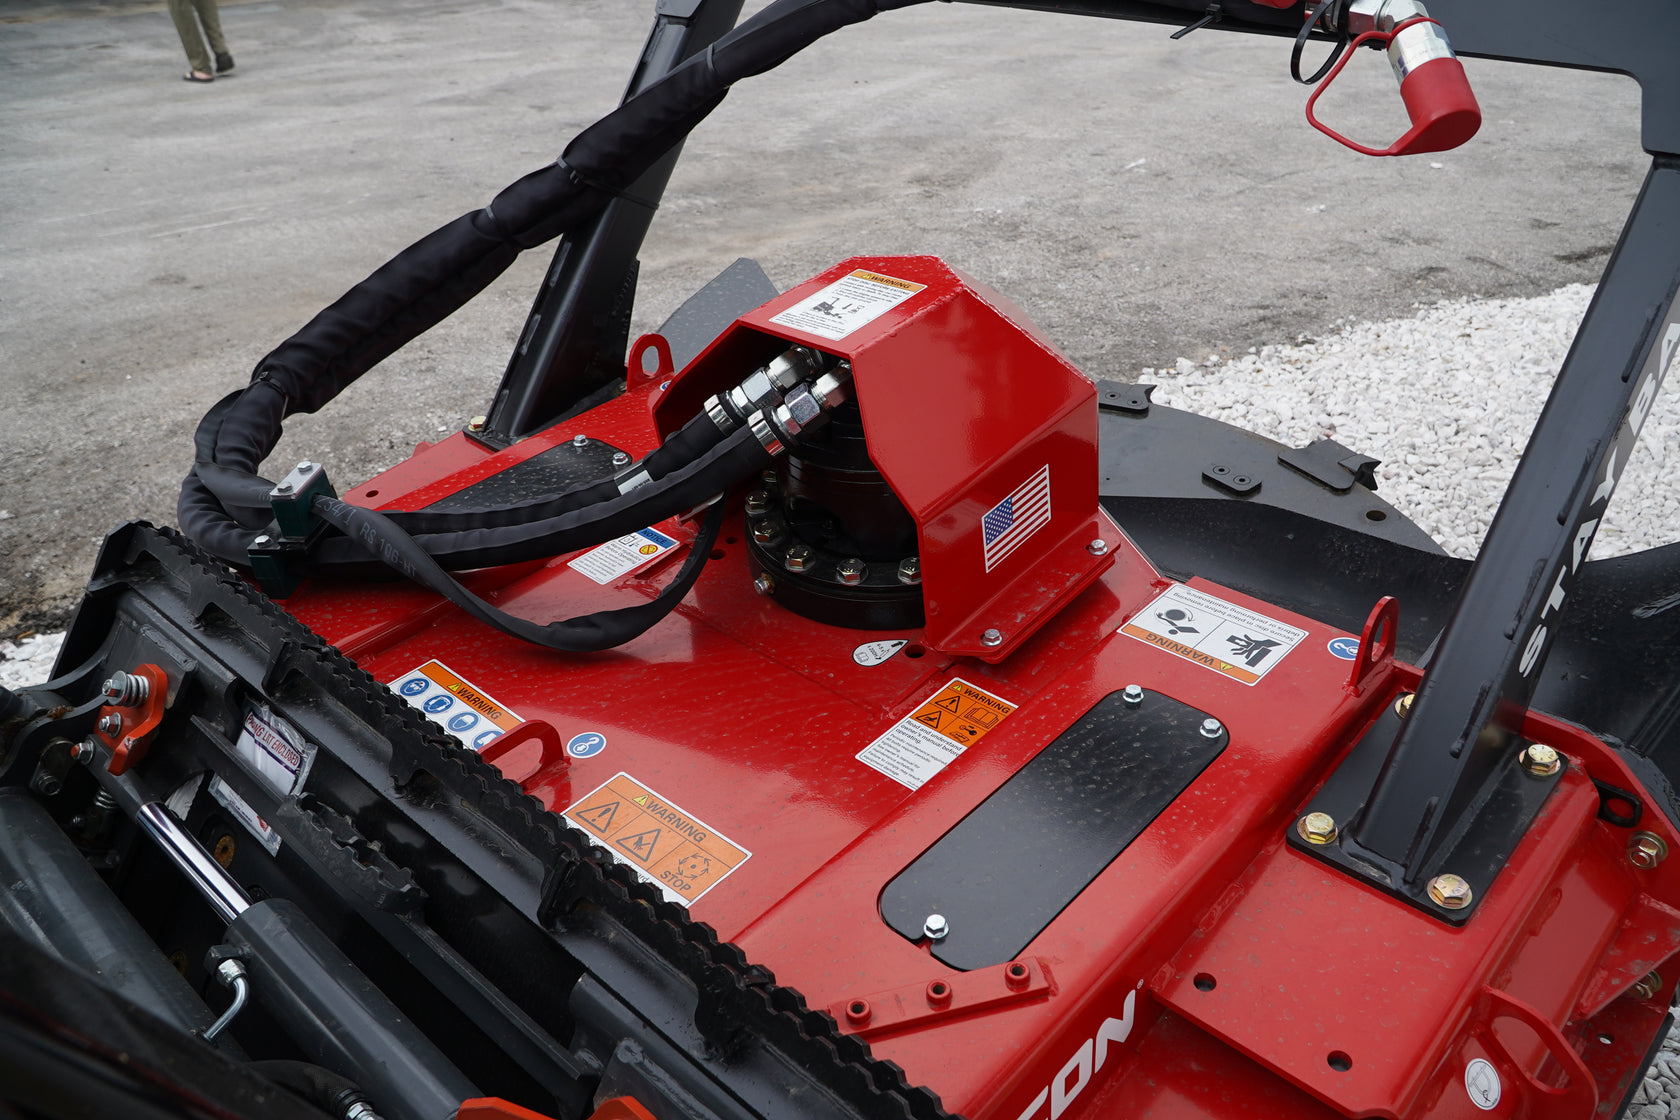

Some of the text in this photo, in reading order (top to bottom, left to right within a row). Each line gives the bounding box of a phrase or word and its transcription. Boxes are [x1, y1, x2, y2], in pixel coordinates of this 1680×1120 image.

[871, 276, 911, 289] WARNING
[640, 529, 668, 544] NOTICE
[1171, 592, 1205, 606] removing
[1202, 604, 1227, 615] before
[1225, 612, 1246, 623] place
[1227, 607, 1269, 624] performing
[1253, 623, 1270, 632] disc
[1268, 629, 1295, 641] Secure
[1276, 625, 1301, 637] debris
[1143, 633, 1216, 665] WARNING
[457, 687, 502, 720] WARNING
[962, 688, 1011, 714] WARNING
[894, 727, 923, 744] operating.
[899, 723, 922, 736] owner's
[920, 734, 943, 747] manual
[905, 720, 962, 751] Read and understand
[271, 738, 300, 767] ENCLOSED
[646, 800, 707, 843] WARNING
[660, 870, 692, 892] STOP
